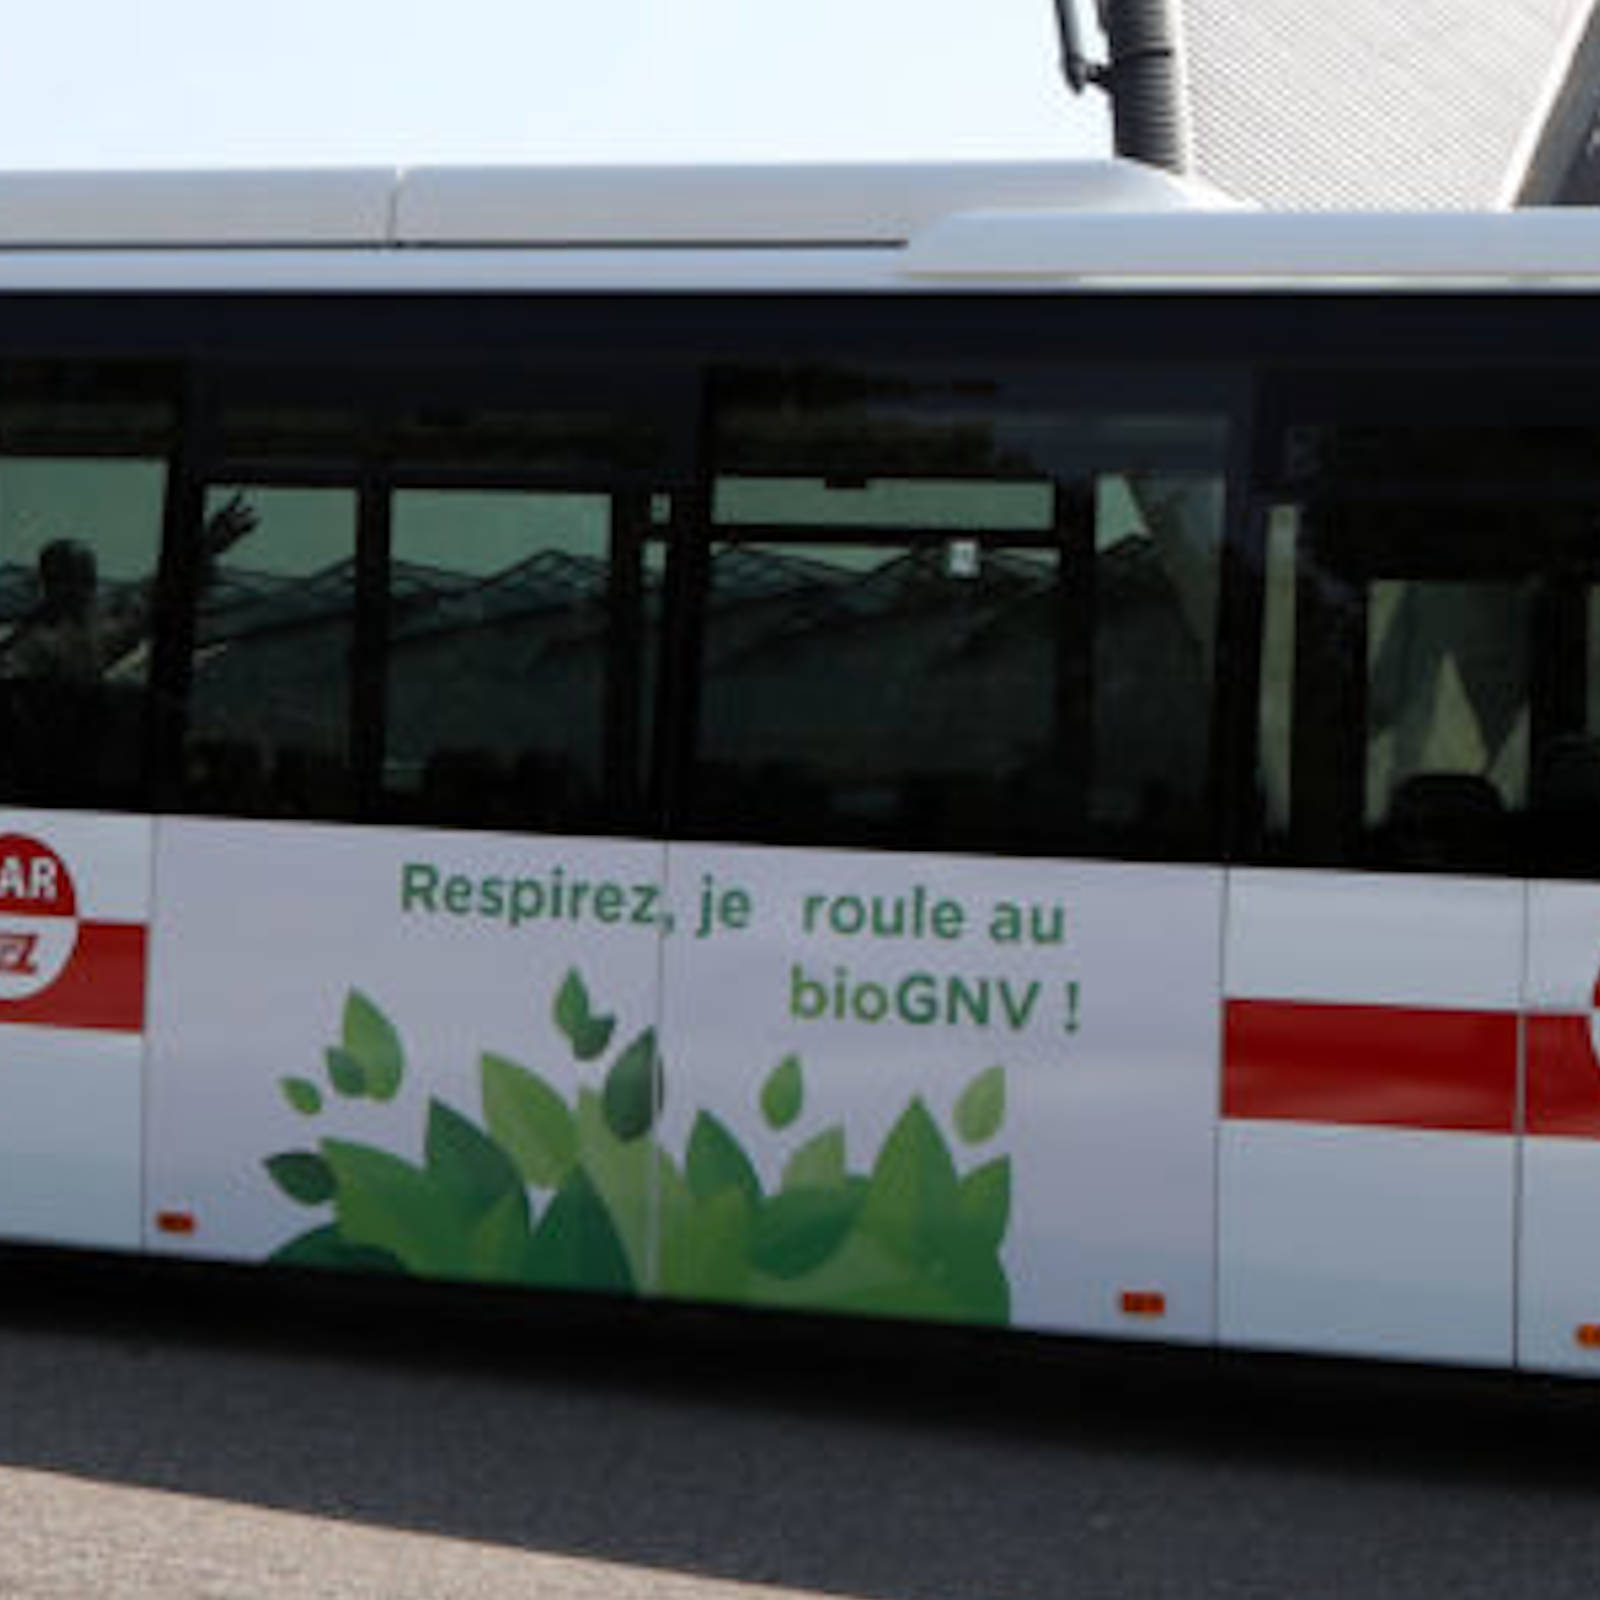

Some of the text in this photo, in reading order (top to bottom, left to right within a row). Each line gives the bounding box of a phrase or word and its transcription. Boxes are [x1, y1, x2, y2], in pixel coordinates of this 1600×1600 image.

[401, 863, 1064, 945] Respirez, je roule au
[789, 961, 1081, 1036] bioGNV !
